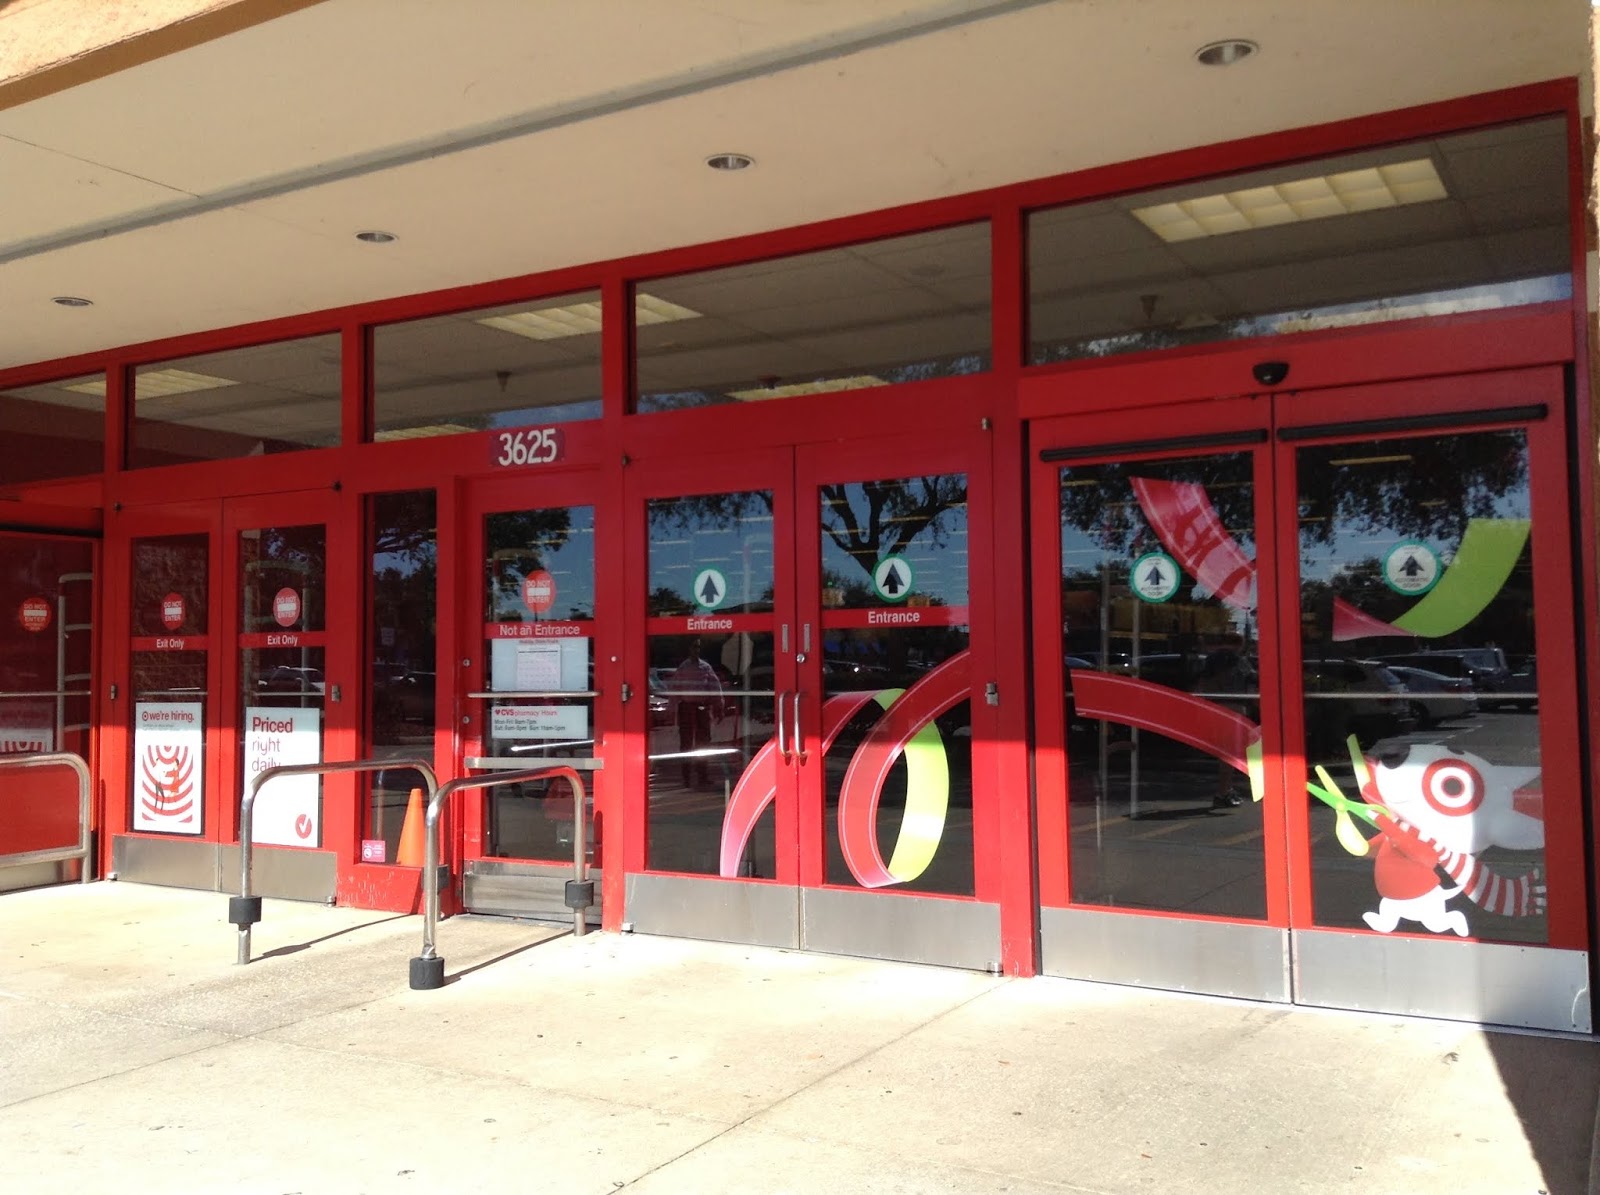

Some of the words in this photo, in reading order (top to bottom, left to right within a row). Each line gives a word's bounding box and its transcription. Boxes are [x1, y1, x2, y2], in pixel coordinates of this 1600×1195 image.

[498, 428, 557, 466] 3625
[526, 580, 536, 588] DO
[285, 595, 297, 603] NOT
[527, 596, 550, 604] ENTER
[278, 611, 296, 619] ENTER
[868, 611, 920, 624] Entrance
[500, 624, 517, 636] Not
[520, 626, 532, 636] an
[535, 624, 580, 636] Entrance
[687, 618, 733, 631] Entrance
[156, 638, 168, 648] Exit
[169, 638, 185, 650] Only
[267, 635, 281, 645] Exit
[281, 634, 298, 647] Only
[149, 710, 169, 721] we're
[171, 710, 195, 723] hiring.
[252, 716, 293, 733] Priced
[252, 736, 281, 756] right
